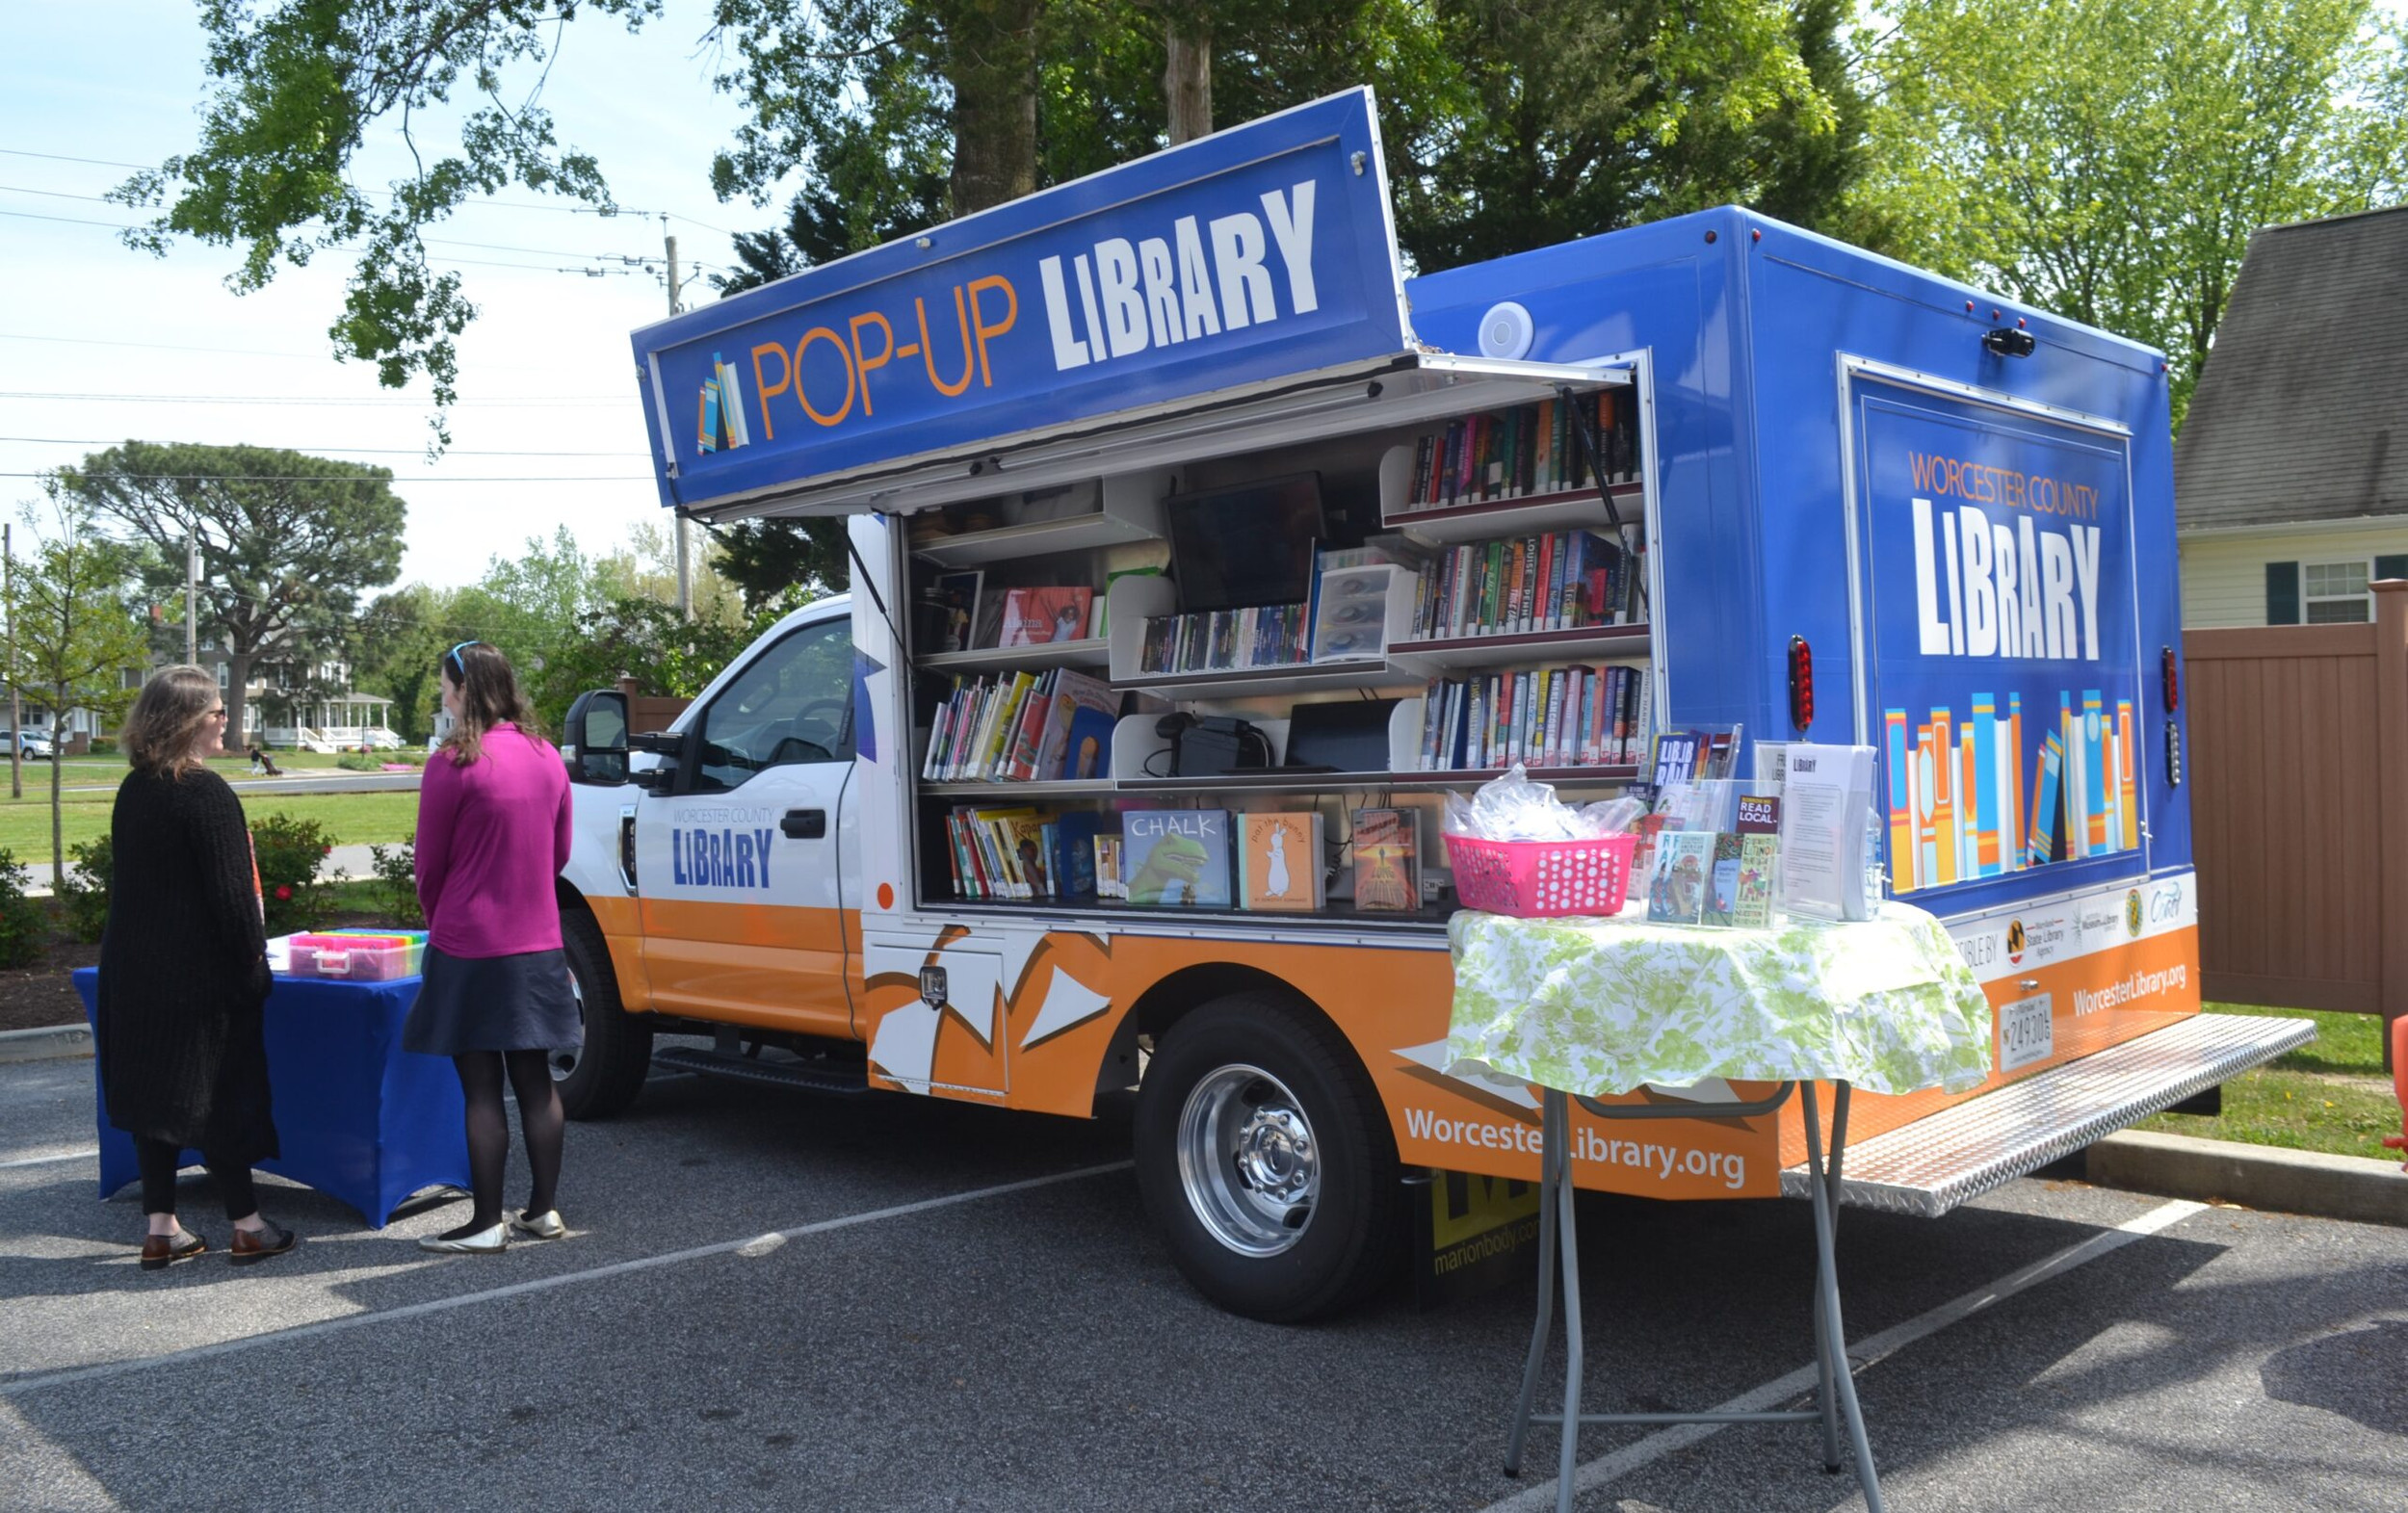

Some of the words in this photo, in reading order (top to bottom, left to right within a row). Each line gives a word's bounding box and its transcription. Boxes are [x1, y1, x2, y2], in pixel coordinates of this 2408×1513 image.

[751, 274, 1018, 441] POP-UP
[1038, 179, 1319, 372] LIBRARY
[1908, 451, 2026, 506] WORCESTER
[2028, 475, 2100, 520] COUNTY
[1525, 538, 1535, 576] LOUISE
[1912, 498, 2101, 661] LIBRARY
[675, 807, 728, 823] WORCESTER
[730, 807, 774, 823] COUNTY
[1741, 801, 1771, 813] READ
[1132, 815, 1217, 838] CHALK
[1283, 817, 1306, 844] bunny
[673, 828, 773, 888] LIBRARY
[1986, 932, 1999, 963] BY
[2026, 934, 2043, 948] State
[2043, 929, 2064, 943] Library
[2074, 964, 2186, 1017] WorcesterLibrary.org
